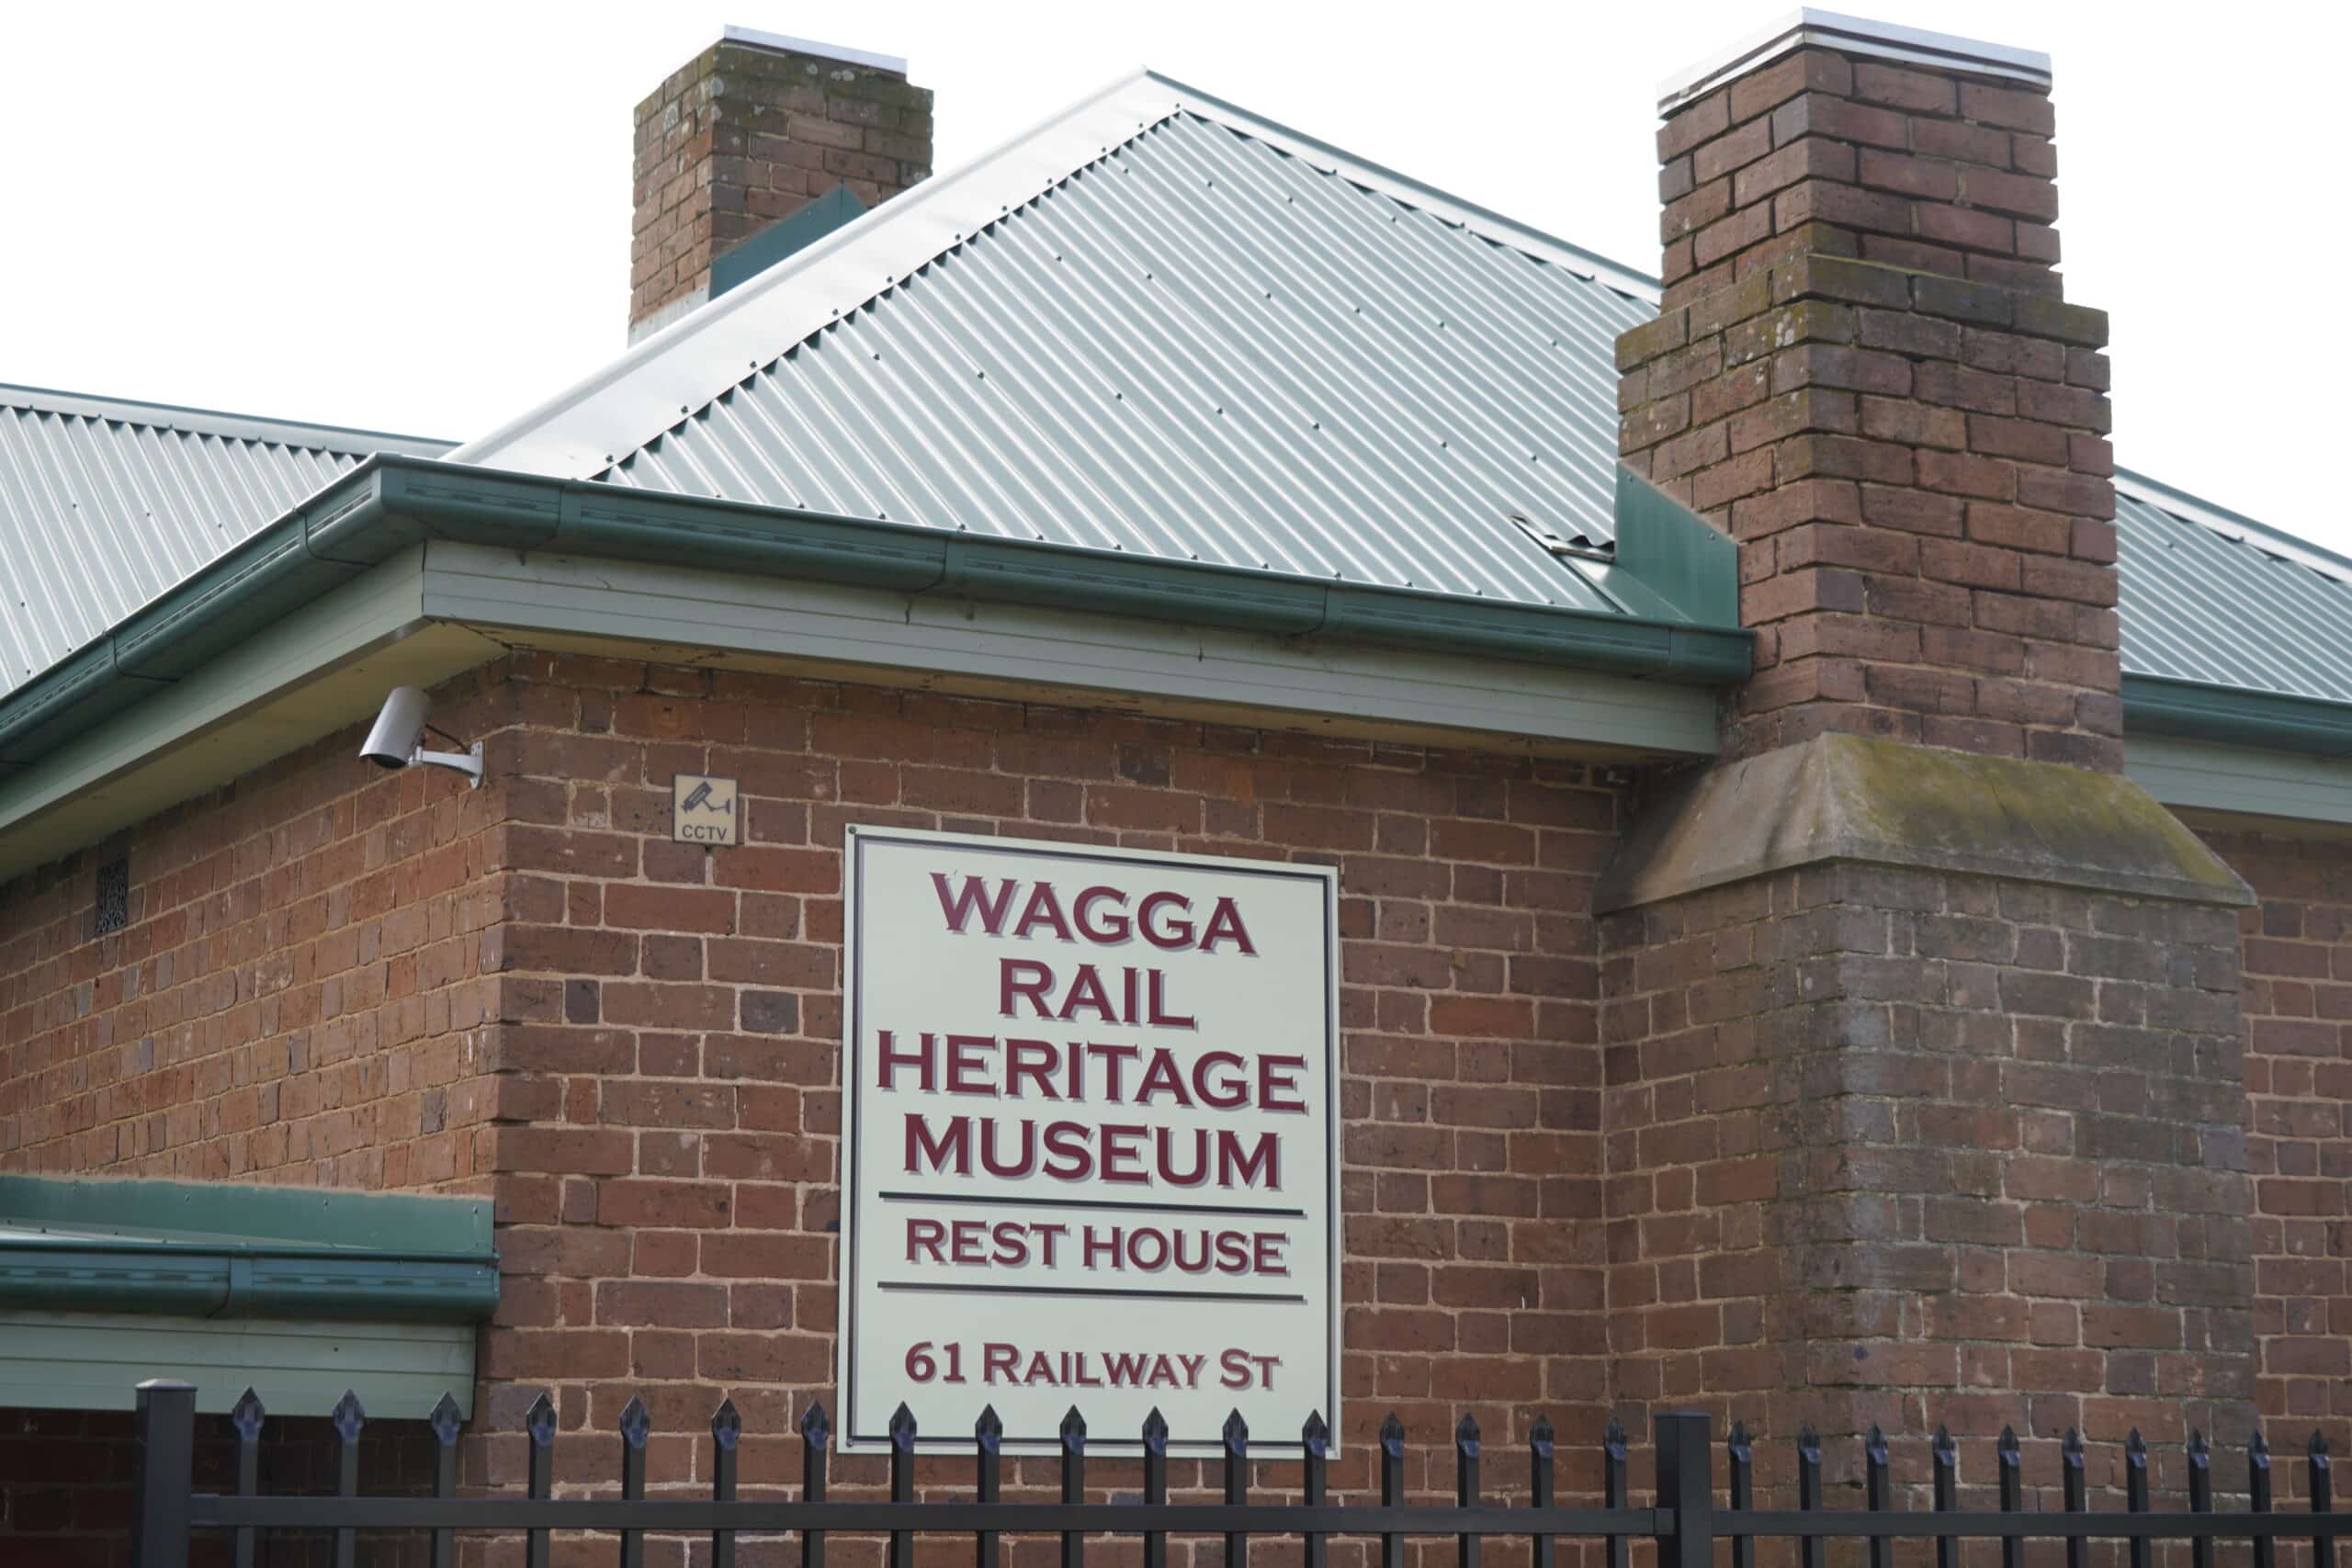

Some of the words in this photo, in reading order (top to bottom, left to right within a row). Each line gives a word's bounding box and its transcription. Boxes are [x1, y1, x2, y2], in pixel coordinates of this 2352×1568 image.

[682, 824, 728, 840] CCTV
[929, 872, 1260, 957] WAGGA
[998, 957, 1198, 1032] RAIL
[876, 1029, 1310, 1117] HERITAGE
[903, 1112, 1283, 1192] MUSEUM
[905, 1217, 1070, 1269] REST
[1082, 1224, 1292, 1279] HOUSE
[904, 1340, 967, 1384] 61
[982, 1342, 1208, 1390] RAILWAY
